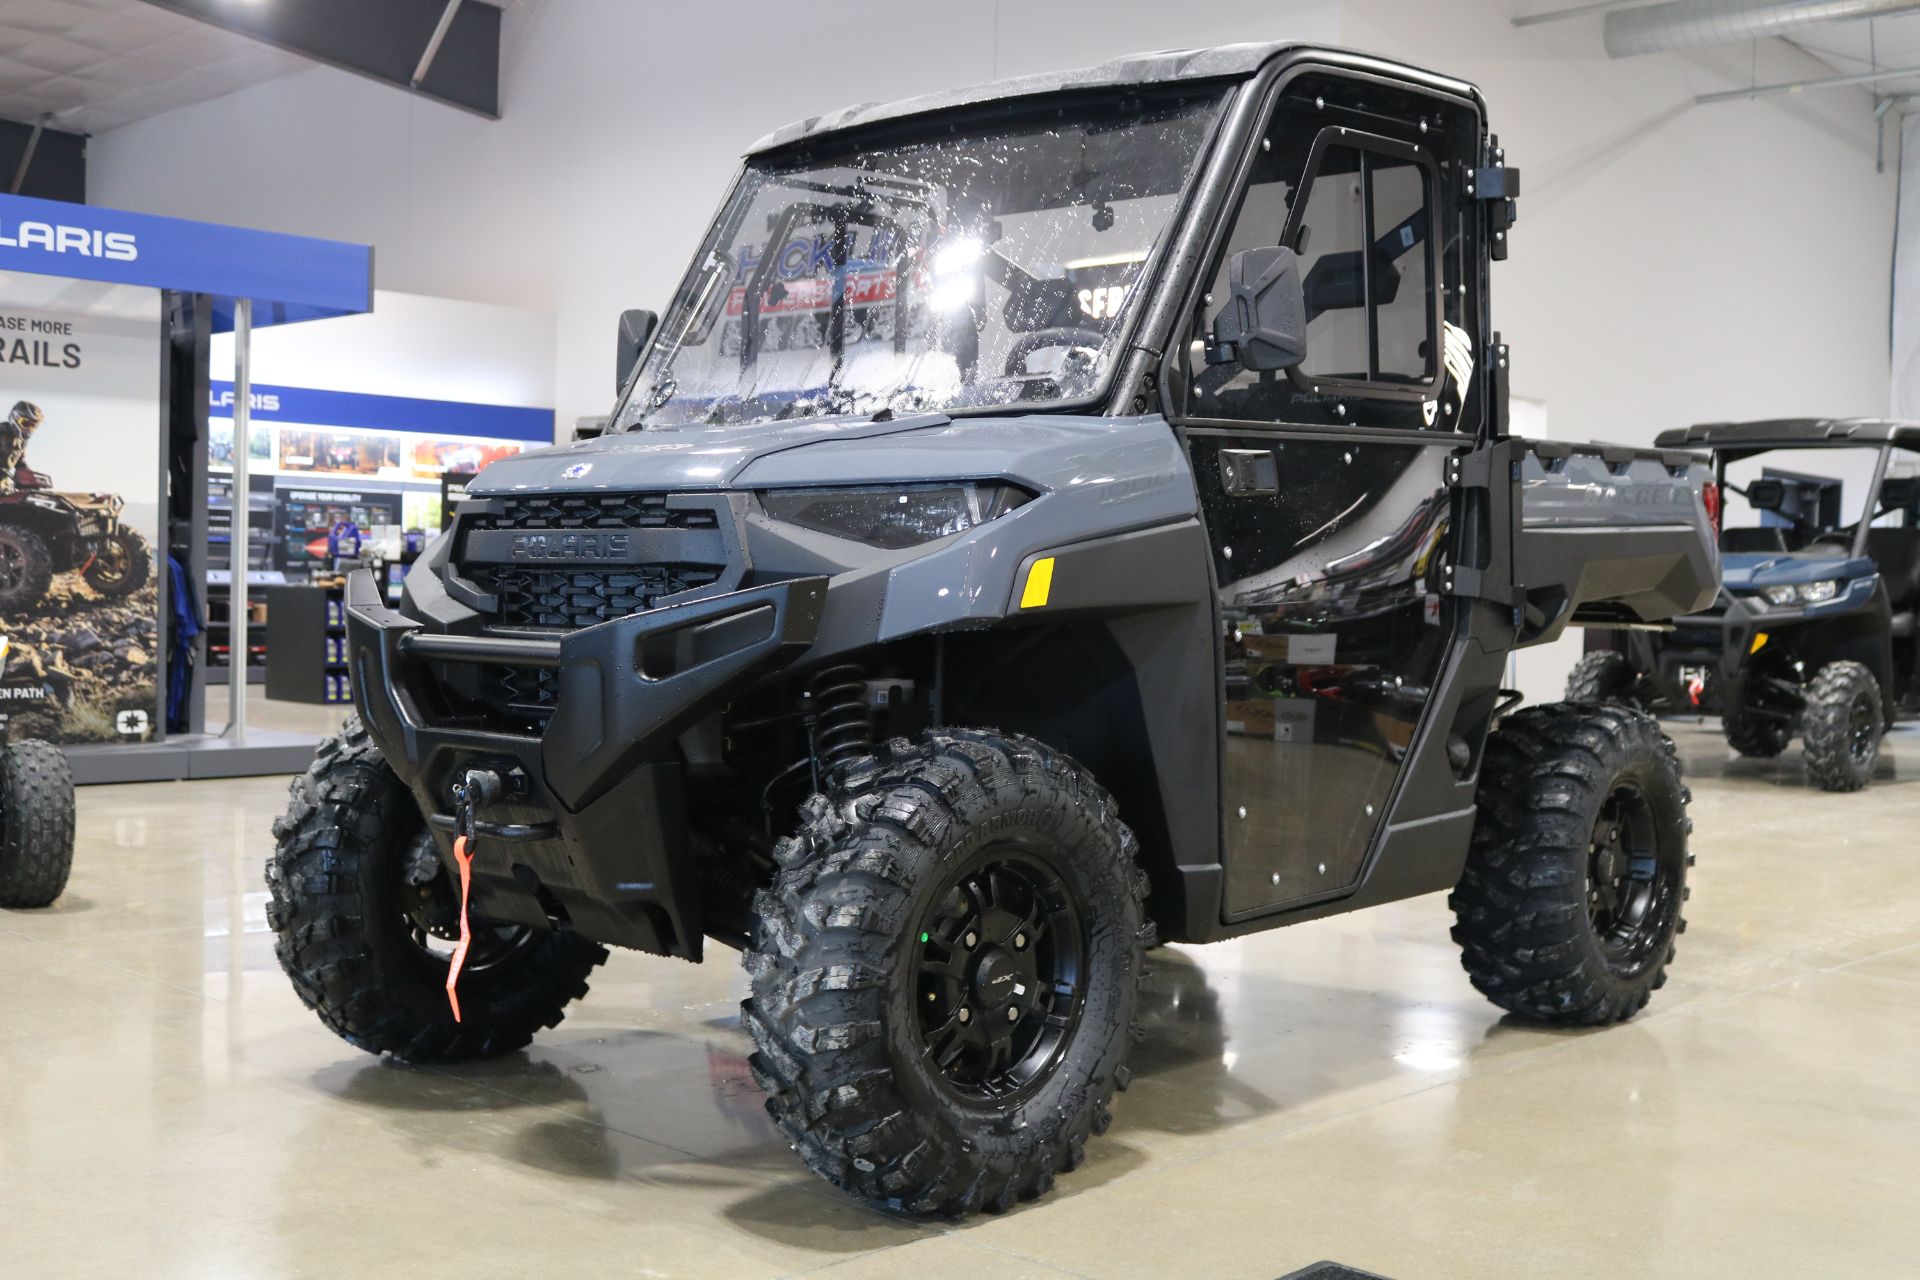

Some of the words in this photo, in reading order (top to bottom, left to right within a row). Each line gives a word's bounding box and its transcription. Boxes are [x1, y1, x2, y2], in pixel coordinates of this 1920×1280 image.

[31, 319, 72, 336] MORE
[511, 534, 630, 559] POLARIS
[13, 687, 45, 699] PATH
